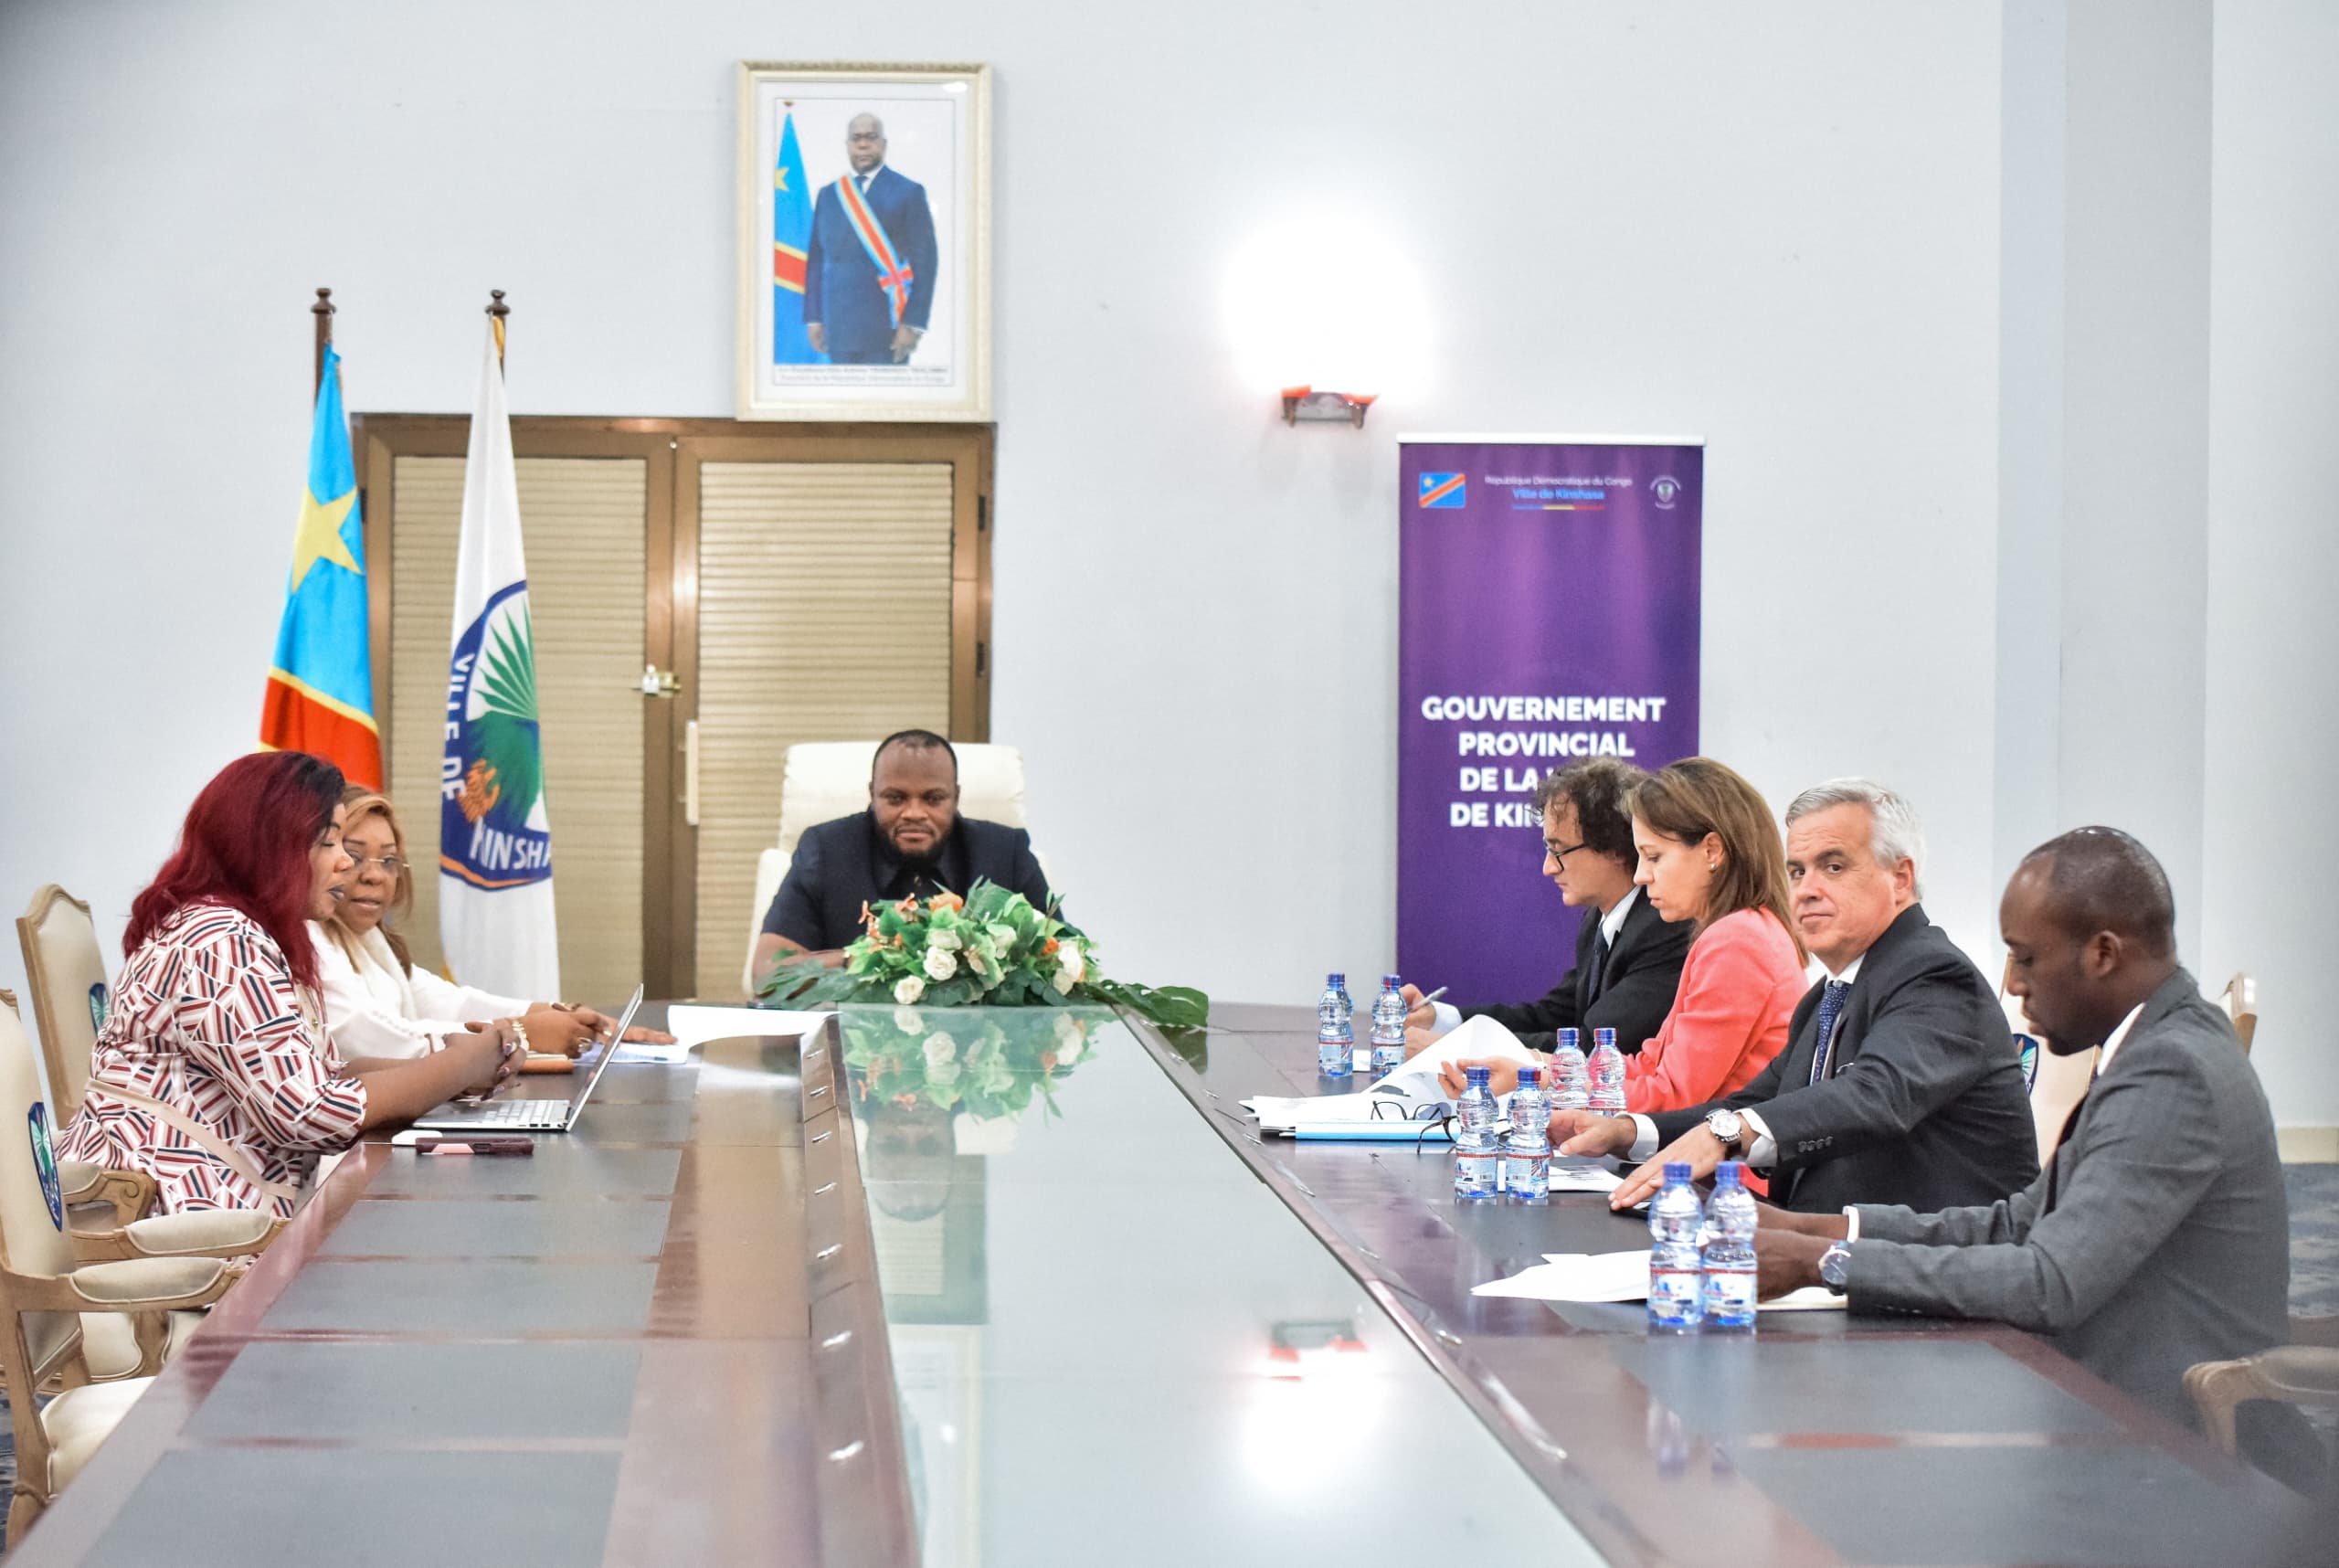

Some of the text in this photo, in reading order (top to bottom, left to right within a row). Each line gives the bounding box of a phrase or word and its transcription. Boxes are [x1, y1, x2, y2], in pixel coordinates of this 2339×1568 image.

[1422, 696, 1666, 722] GOUVERNEMENT
[1459, 732, 1635, 757] PROVINCIAL
[441, 756, 468, 801] DE
[1460, 768, 1499, 791] DE
[1505, 768, 1538, 791] LA
[1451, 803, 1488, 827] DE
